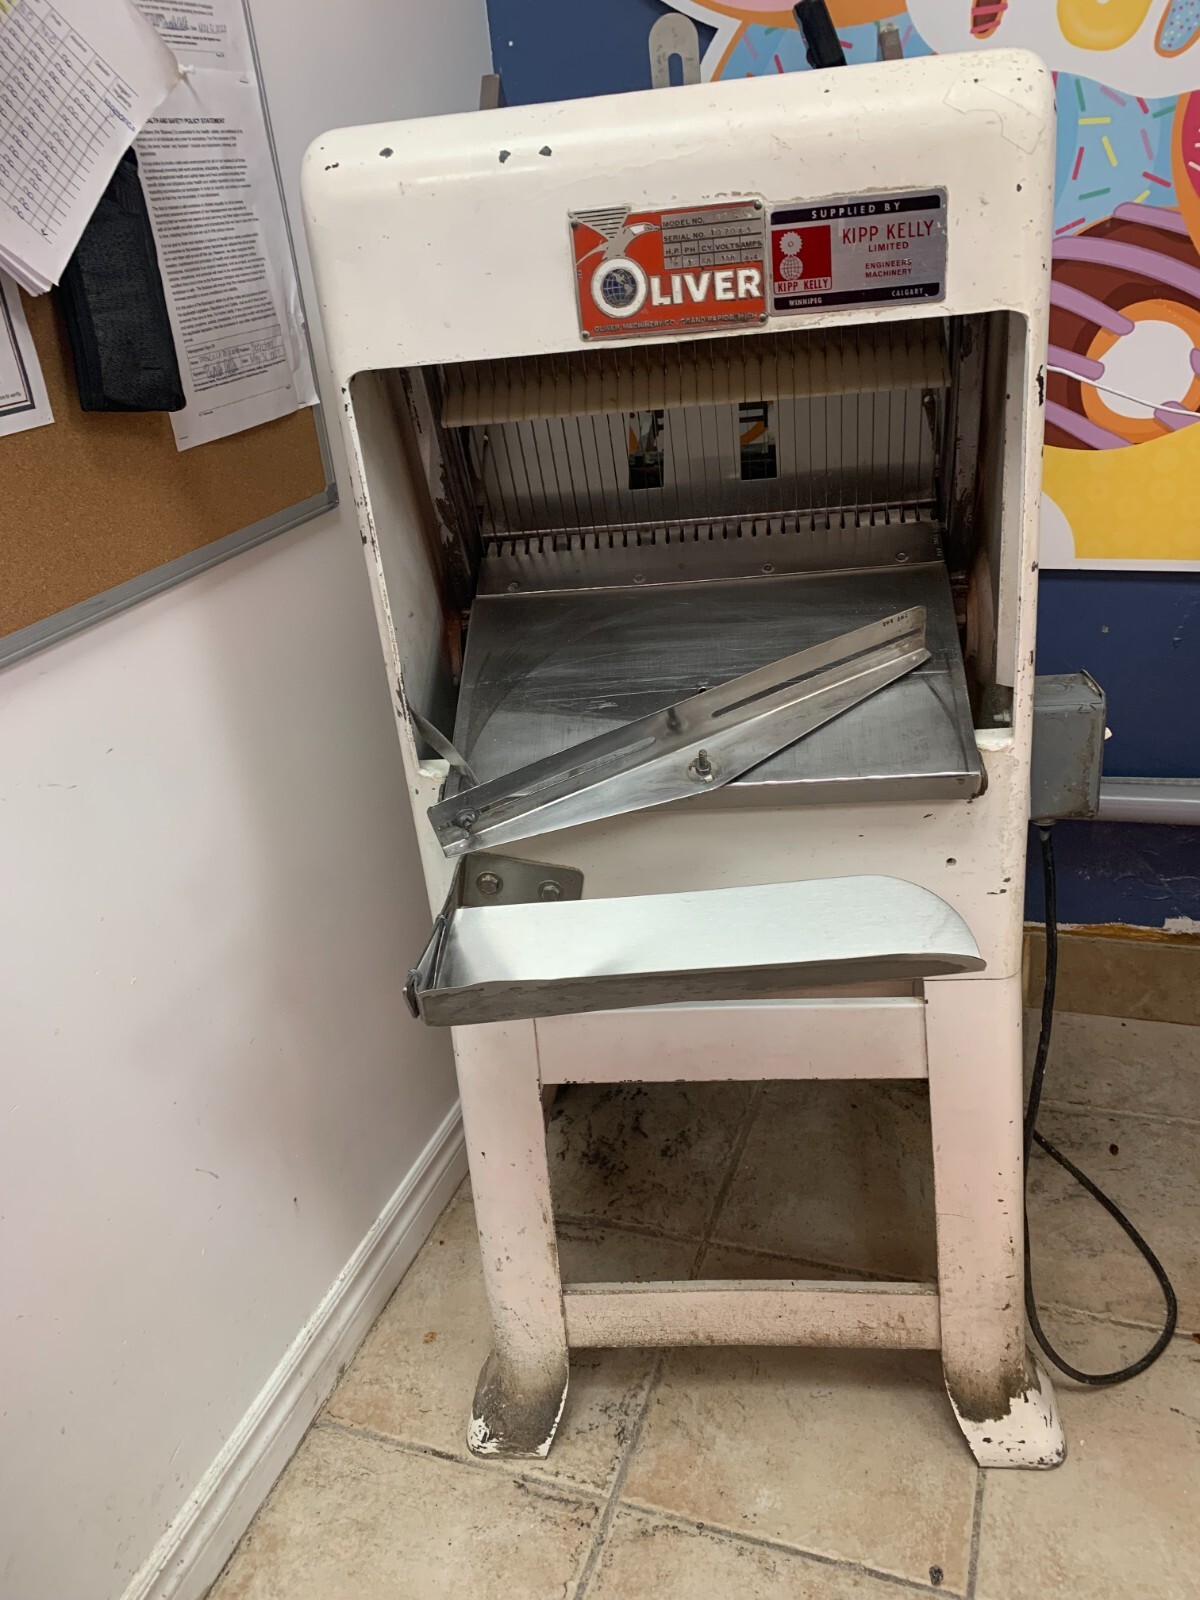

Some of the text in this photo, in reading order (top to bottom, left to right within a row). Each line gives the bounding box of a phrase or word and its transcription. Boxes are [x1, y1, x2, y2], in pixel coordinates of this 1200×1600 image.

[811, 201, 901, 220] SUPPLIED BY
[662, 217, 689, 227] MODEL
[663, 232, 690, 242] SERIAL
[842, 219, 934, 245] KIPP KELLY
[715, 242, 741, 251] VOLTS
[741, 240, 763, 248] AMPS
[868, 241, 909, 253] LIMITED
[864, 258, 913, 270] ENGINEERS
[864, 268, 913, 279] MACHINERY
[590, 256, 764, 319] OLIVER
[777, 278, 830, 293] KIPP KELLY
[891, 287, 924, 297] CALGARY
[788, 296, 823, 306] WINNIPEG
[593, 324, 621, 333] OLIVER
[622, 319, 663, 331] MACHINERY
[680, 316, 706, 325] GRAND
